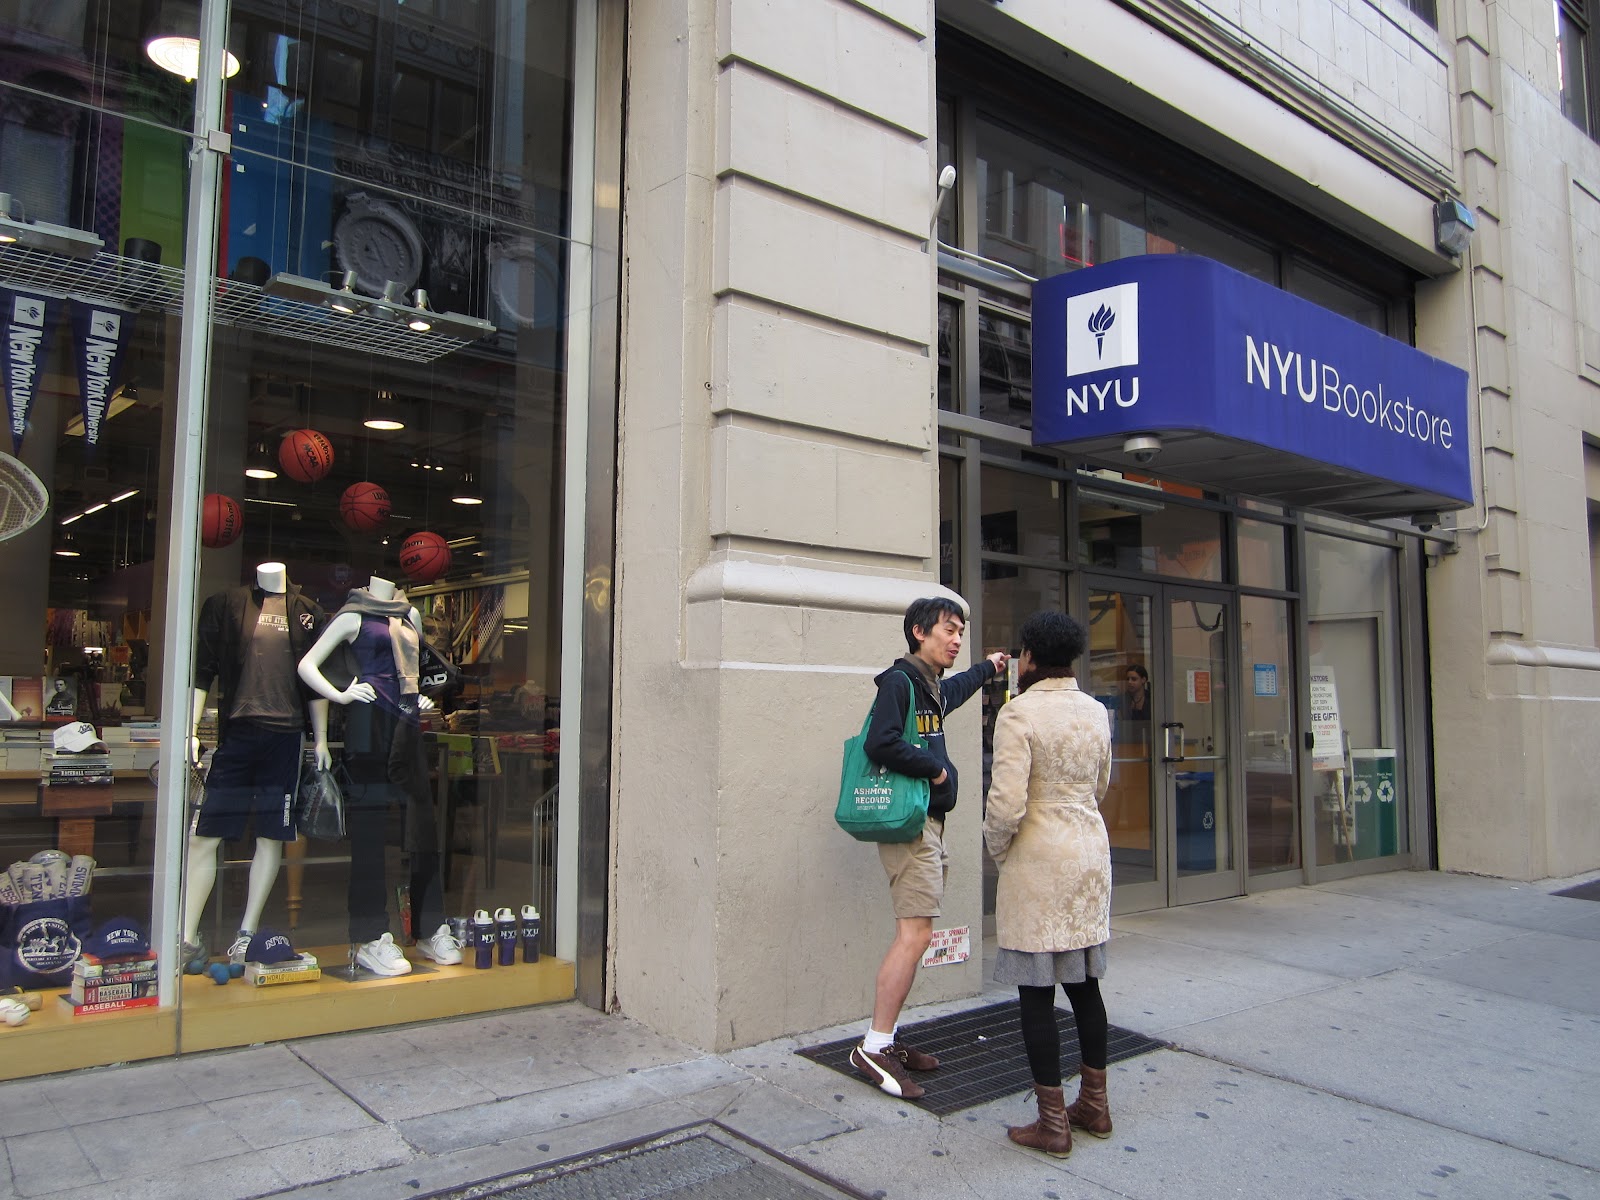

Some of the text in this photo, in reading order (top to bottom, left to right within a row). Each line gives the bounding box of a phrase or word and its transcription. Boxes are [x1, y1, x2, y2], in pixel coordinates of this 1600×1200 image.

[1066, 377, 1140, 416] NYU
[221, 501, 234, 540] Wilson
[421, 673, 448, 687] AD
[1310, 712, 1338, 722] REE GIFT!
[854, 787, 893, 795] ASHMONT
[855, 796, 891, 804] RECORDS
[106, 929, 139, 943] NEW YORK
[948, 927, 968, 937] SPRINKLER
[86, 978, 105, 986] STAN
[106, 975, 132, 984] MUSIAL
[99, 987, 131, 997] BASEBALL
[82, 1000, 126, 1012] BASEBALL
